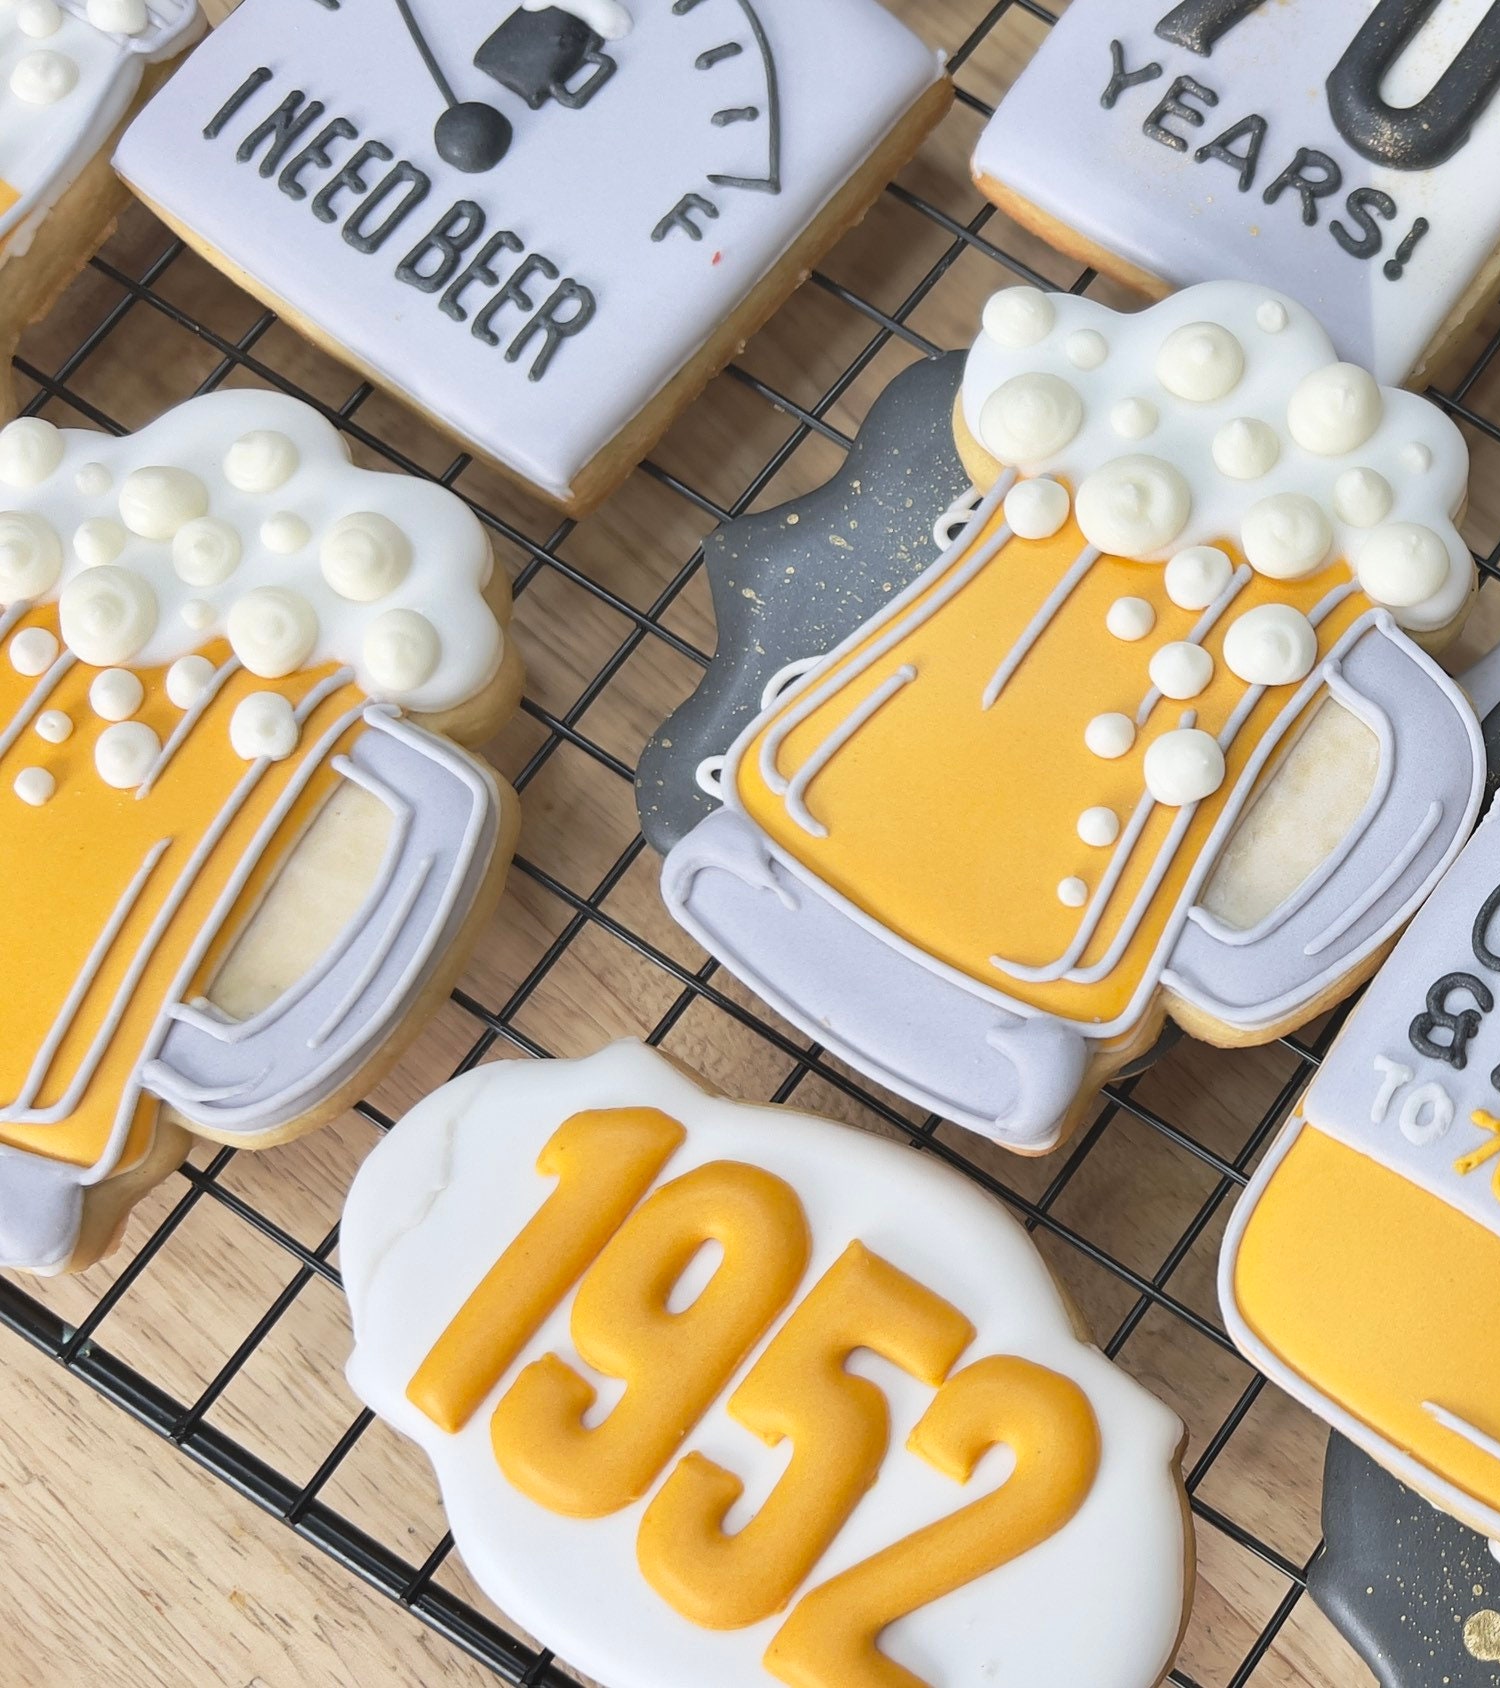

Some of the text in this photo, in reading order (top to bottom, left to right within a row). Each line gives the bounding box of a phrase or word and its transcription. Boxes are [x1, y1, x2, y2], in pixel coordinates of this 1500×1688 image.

[202, 66, 598, 382] I NEED BEER
[651, 192, 720, 243] F
[1099, 38, 1430, 282] YEARS!
[1373, 1054, 1454, 1147] TO
[1409, 972, 1494, 1070] &
[405, 1106, 1103, 1688] 1952
